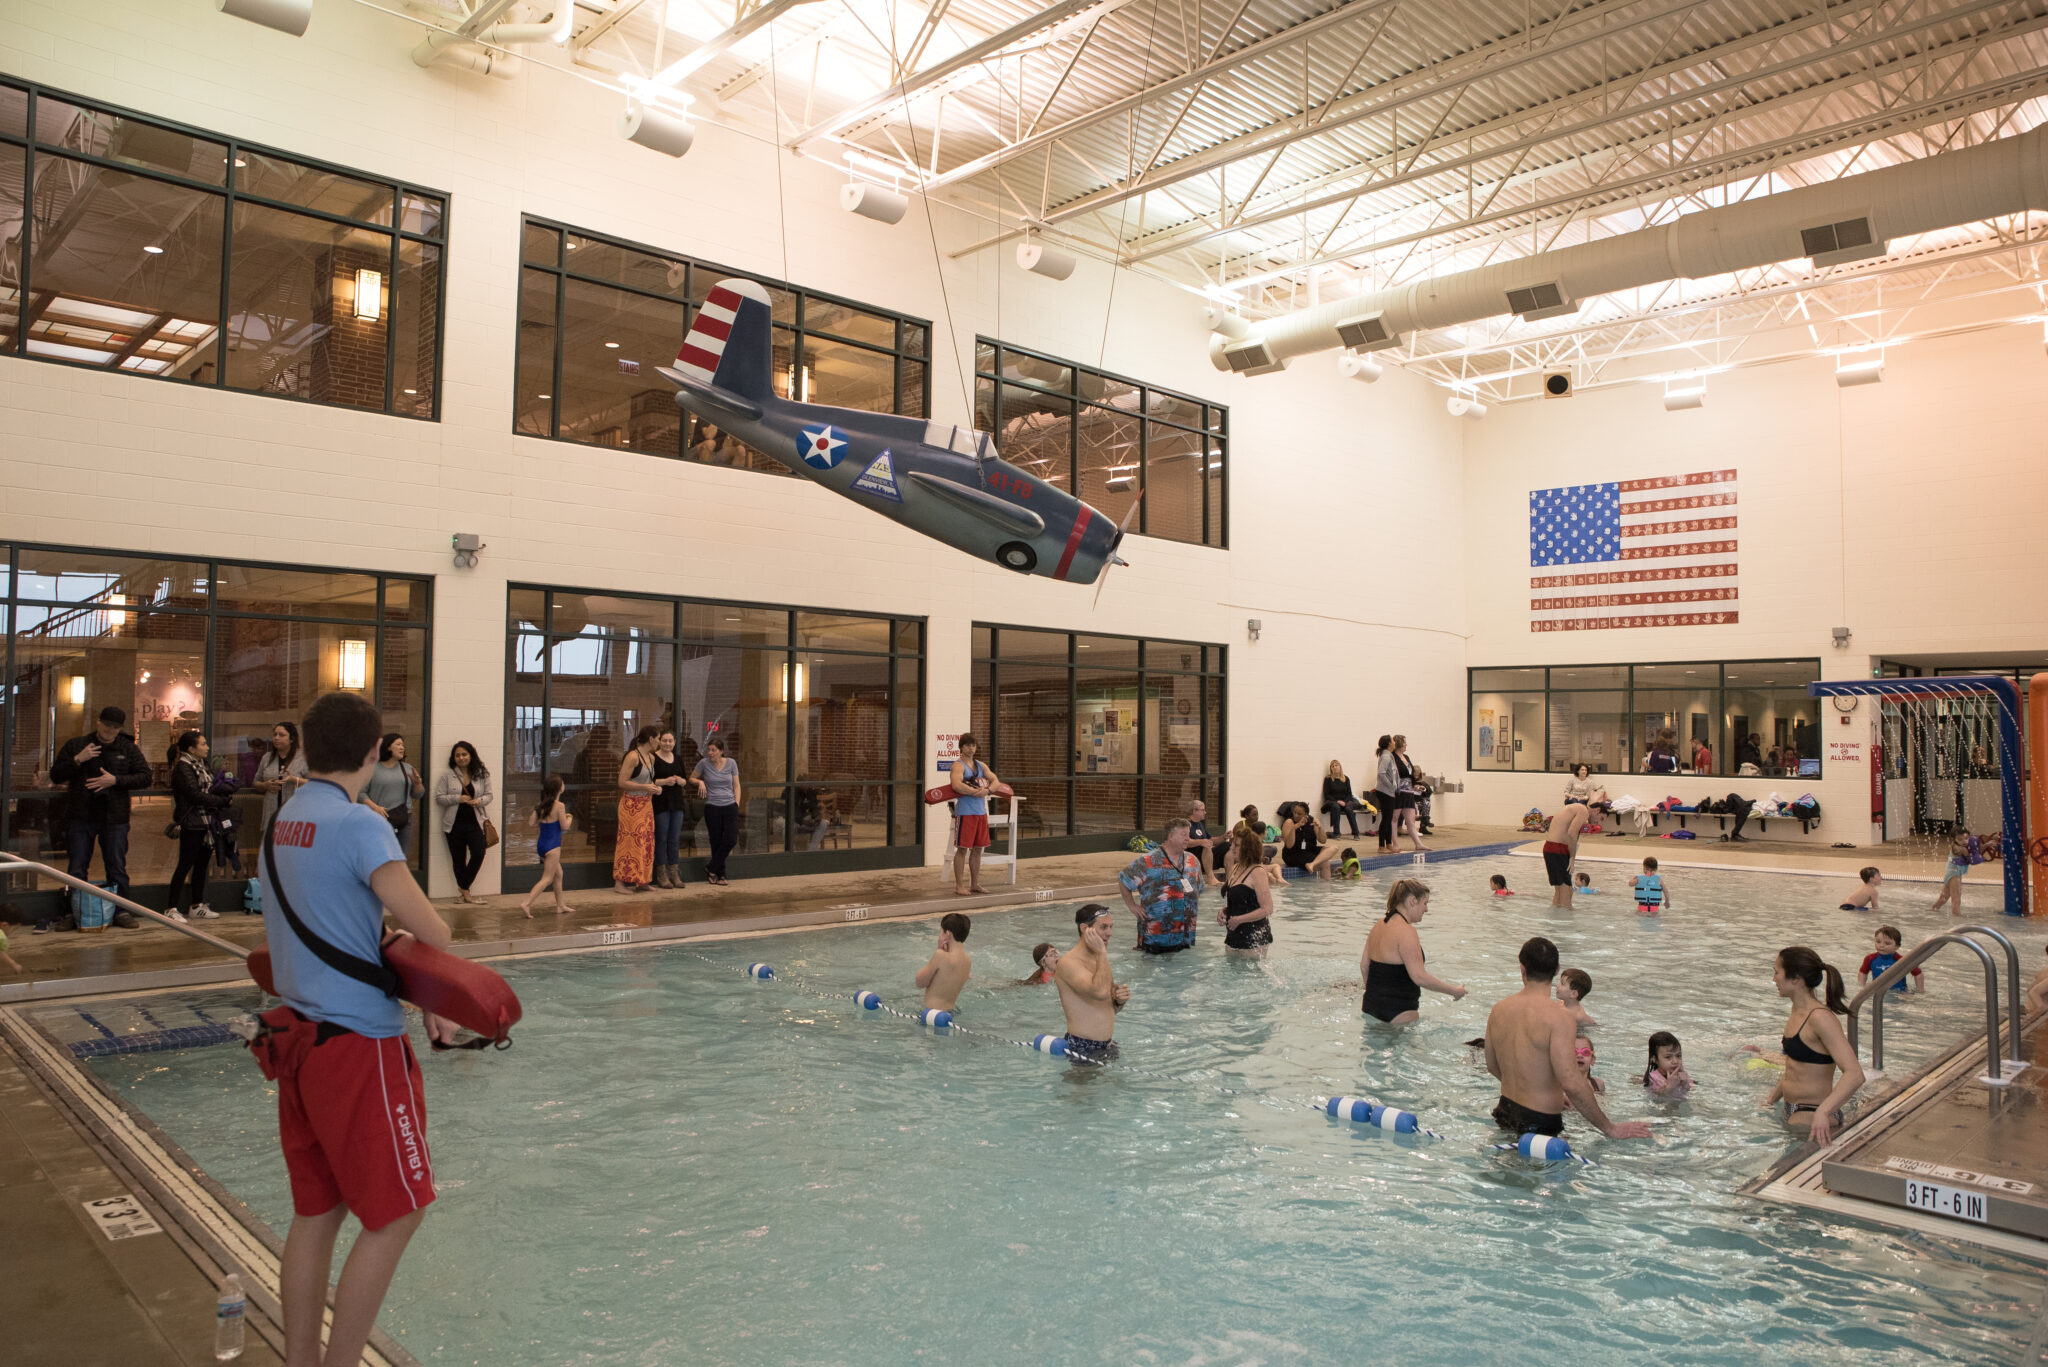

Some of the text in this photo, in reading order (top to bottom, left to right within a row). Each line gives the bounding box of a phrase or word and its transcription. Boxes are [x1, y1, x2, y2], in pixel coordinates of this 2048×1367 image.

[988, 471, 1033, 499] 41-F8
[272, 820, 317, 848] GUARD
[609, 933, 616, 943] FT
[624, 931, 630, 941] IN
[398, 1115, 422, 1169] GUARD
[2002, 1181, 2028, 1191] 3
[92, 1197, 128, 1207] 3
[1909, 1183, 1917, 1204] 3
[1922, 1186, 1938, 1208] FT
[1953, 1193, 1961, 1214] 6
[1967, 1195, 1982, 1219] IN
[102, 1209, 138, 1219] 3
